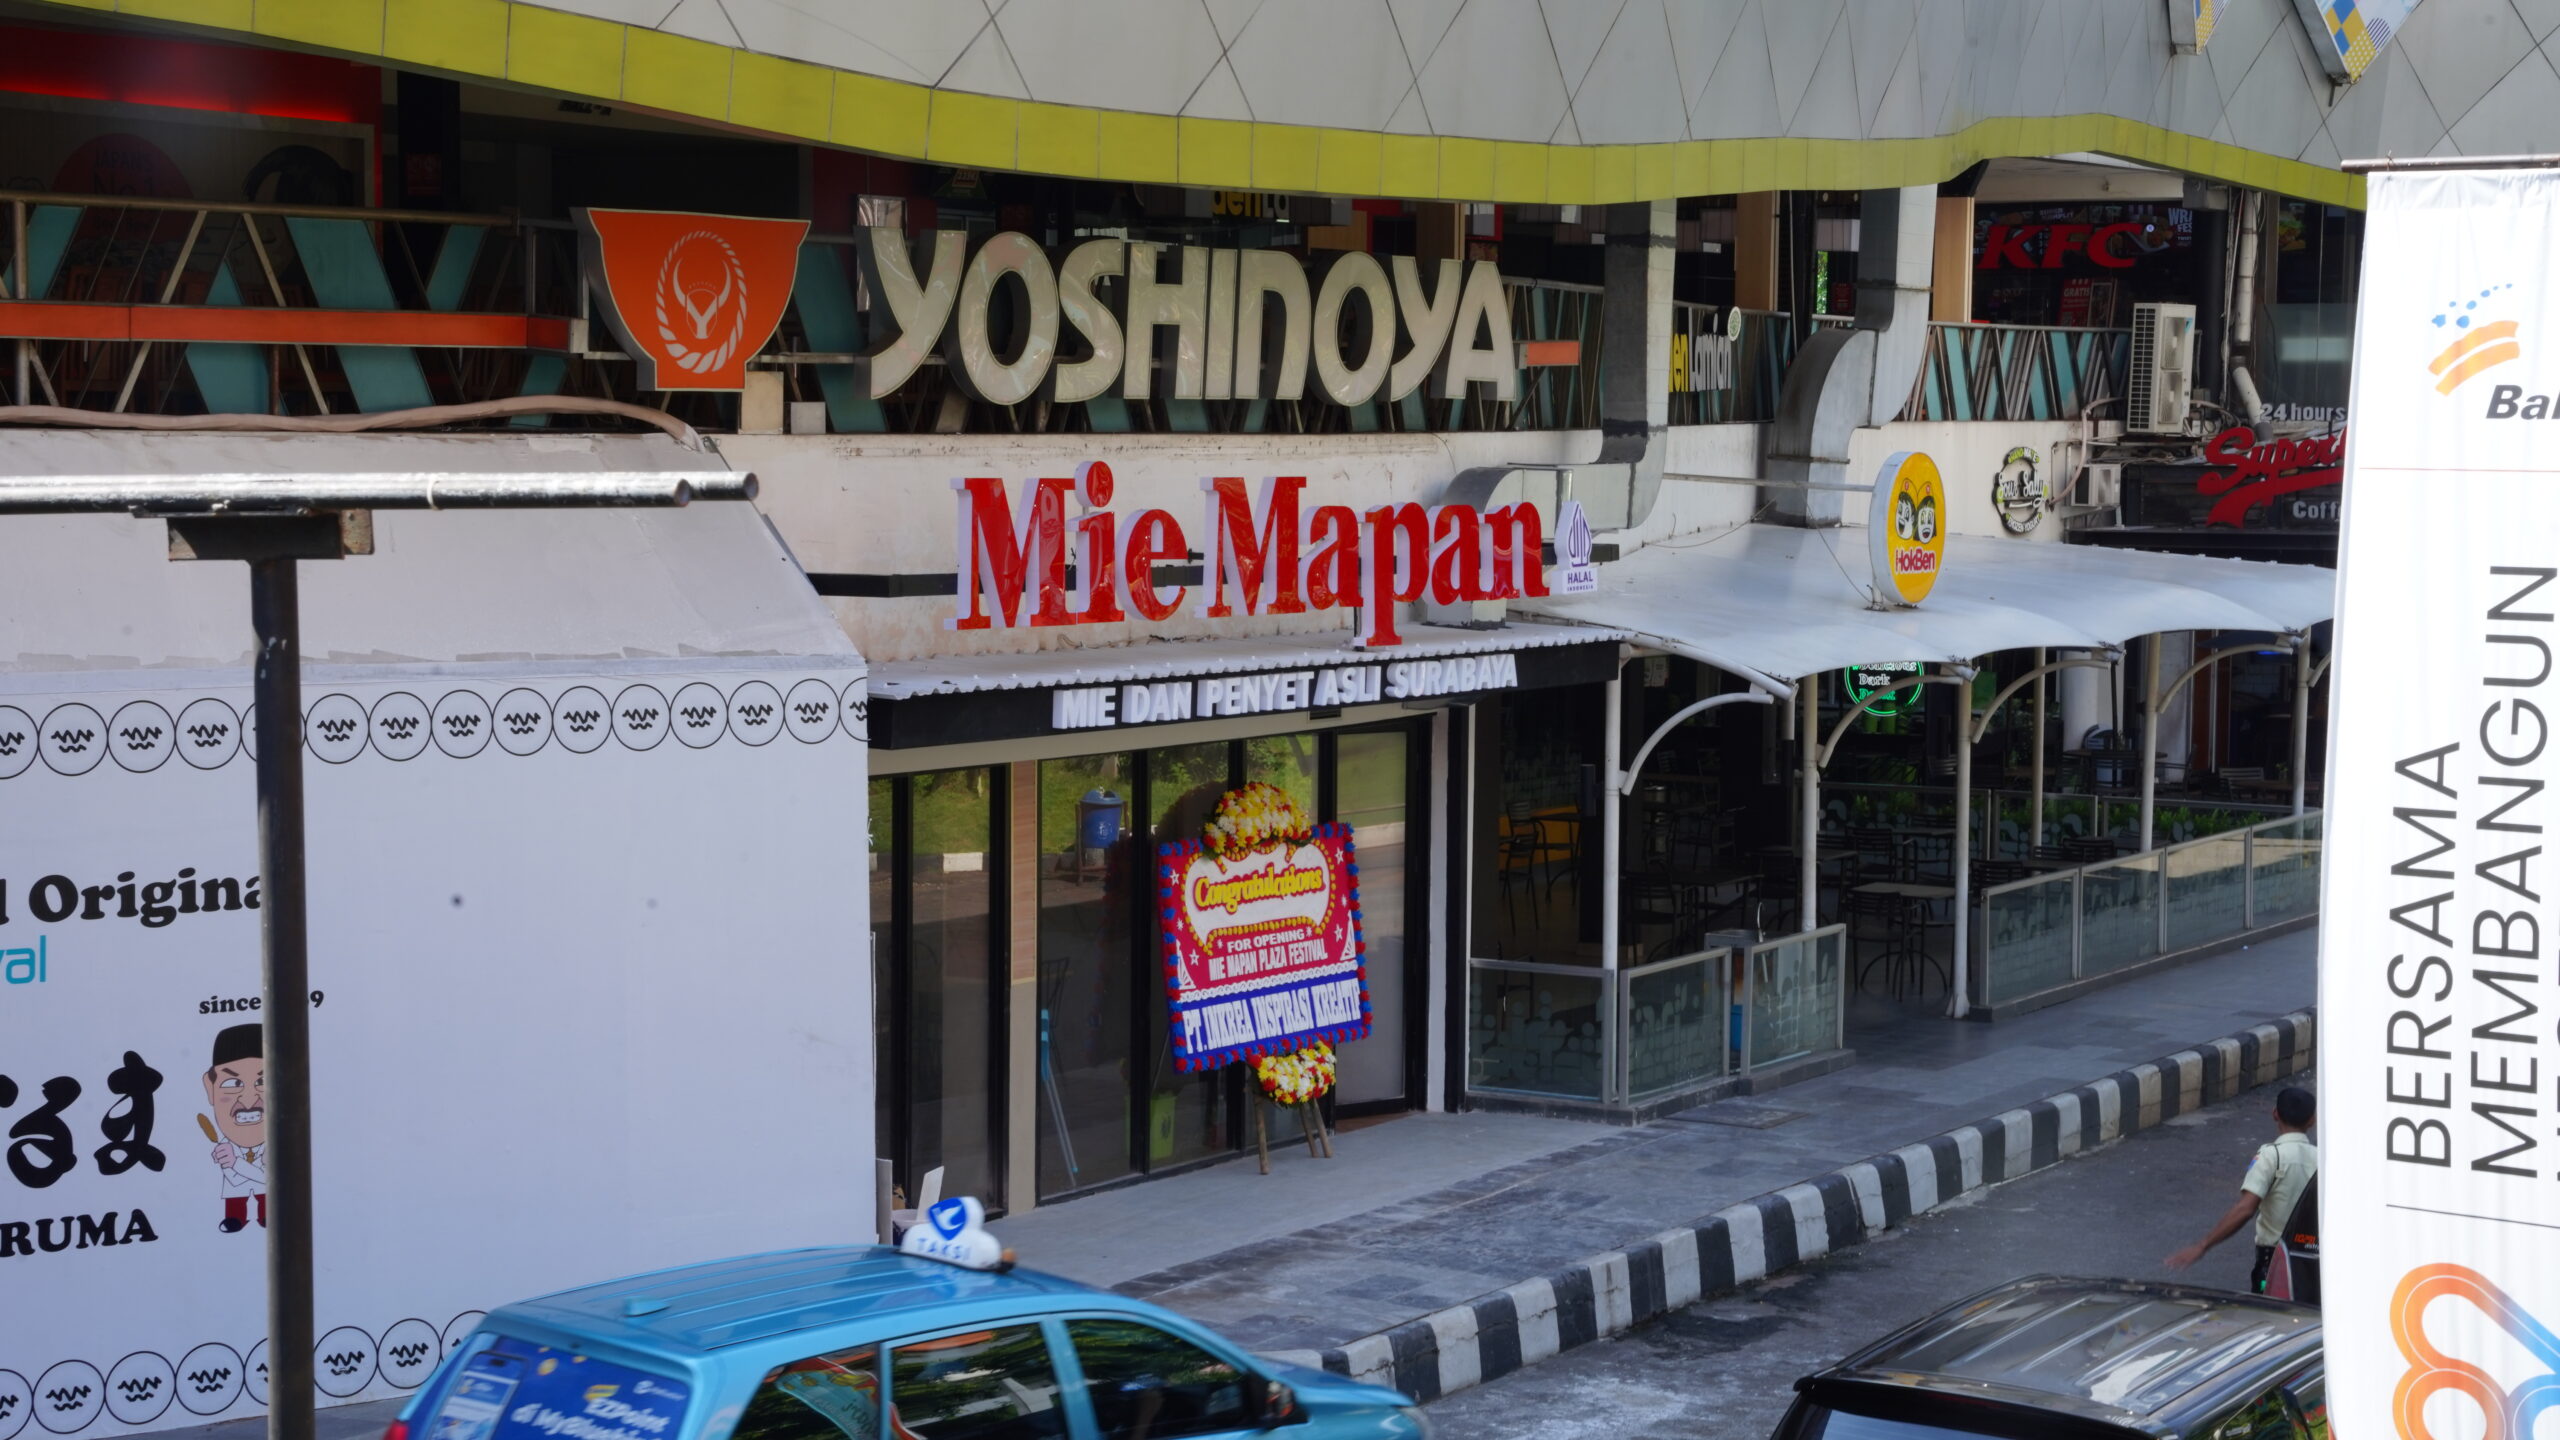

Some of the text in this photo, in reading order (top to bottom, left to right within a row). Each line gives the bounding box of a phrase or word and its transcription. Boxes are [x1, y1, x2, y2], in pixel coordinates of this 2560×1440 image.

[1977, 222, 2143, 269] KFC
[860, 226, 1516, 406] YOSHINOYA
[2260, 402, 2346, 421] 24 hours
[950, 460, 1550, 647] Mie Mapan
[1894, 548, 1936, 574] HokBen
[1567, 571, 1593, 584] HALAL
[1053, 654, 1518, 729] MIE DAN PENYET ASLI SURABAYA
[1858, 673, 1891, 686] Dark
[1195, 865, 1323, 914] Congratulations
[2471, 566, 2558, 1179] MEMBANGUN
[1226, 952, 1258, 978] MAPAN
[1259, 946, 1288, 972] PLAZA
[1288, 938, 1329, 966] FESTIVAL
[1227, 929, 1305, 953] FOR OPENING
[2386, 742, 2460, 1168] BERSAMA
[199, 995, 262, 1015] since
[1251, 987, 1315, 1040] INSPIRASI
[1311, 977, 1362, 1028] KREATIF
[914, 1237, 972, 1261] TAKSI
